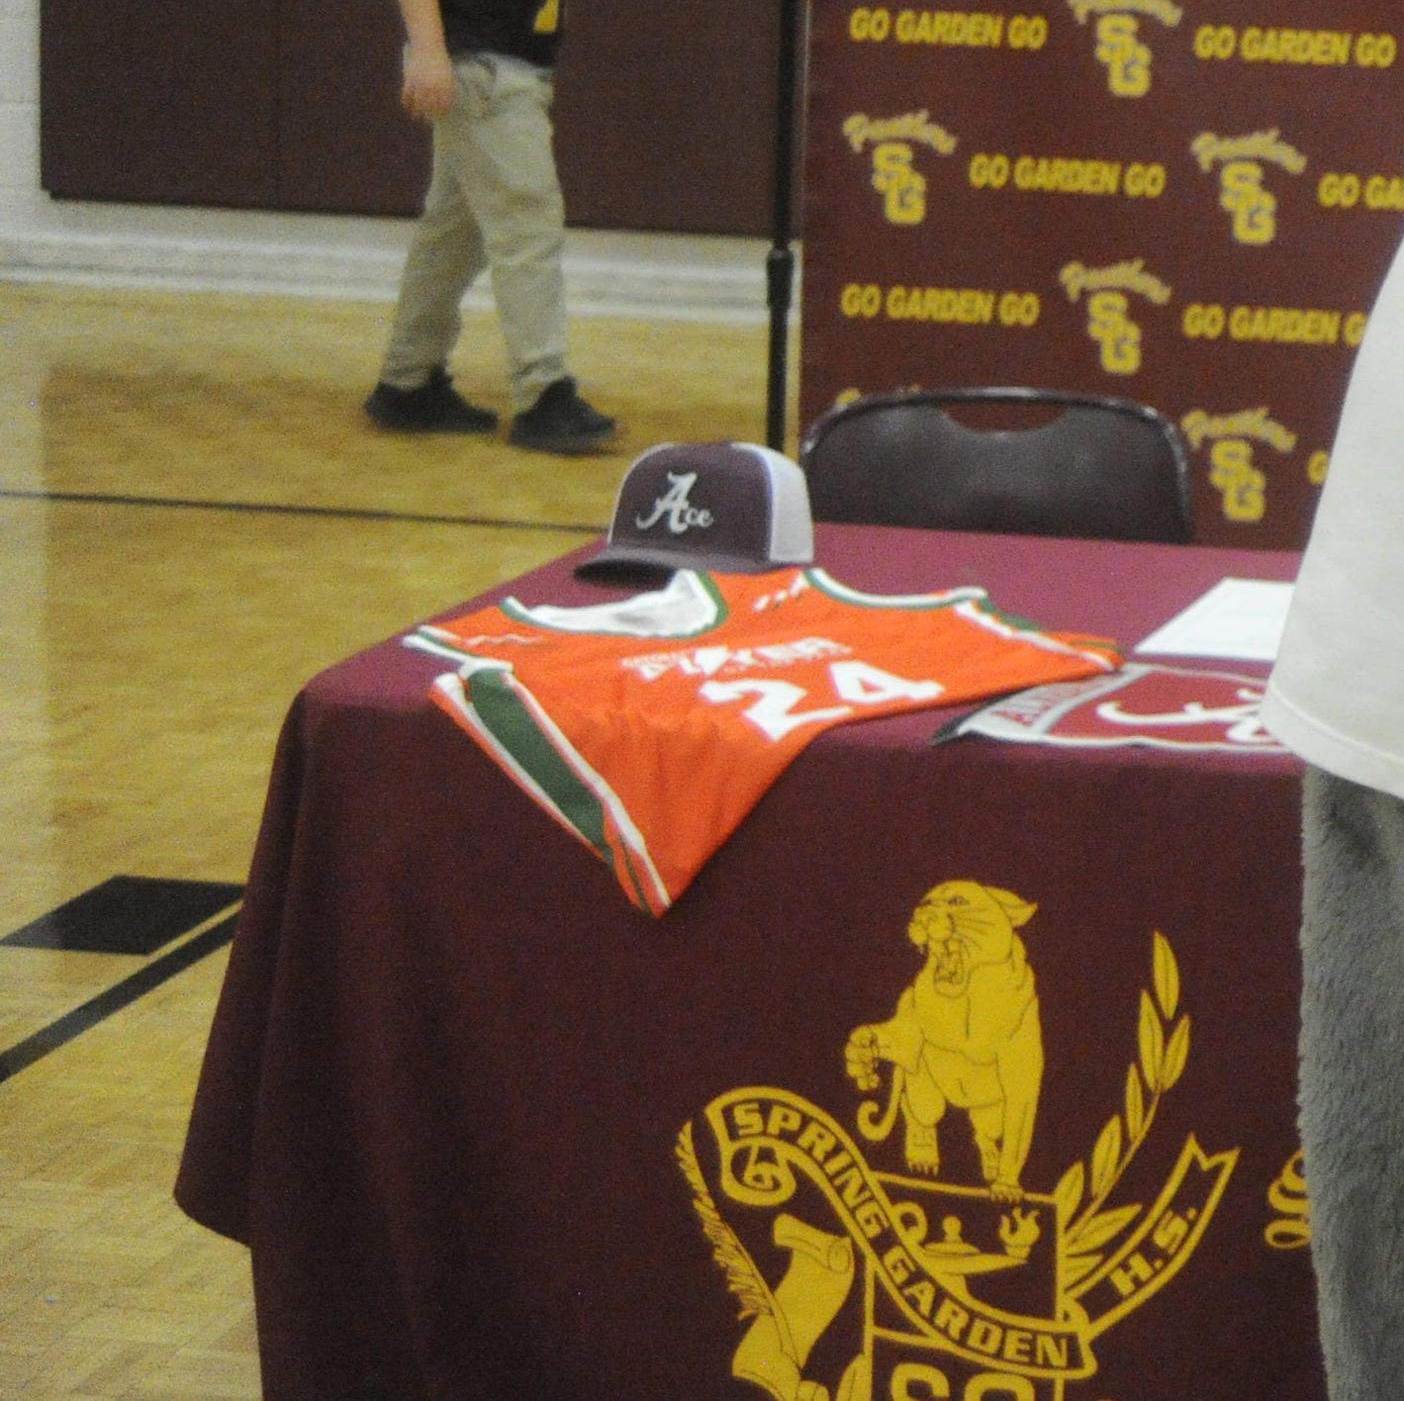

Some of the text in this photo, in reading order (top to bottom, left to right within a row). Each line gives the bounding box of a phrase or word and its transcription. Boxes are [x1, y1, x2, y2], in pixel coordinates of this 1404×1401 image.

[850, 6, 1049, 50] GO GARDEN GO
[1195, 24, 1399, 69] GO GARDEN GO
[968, 153, 1168, 199] GO GARDEN GO
[1318, 171, 1361, 209] GO
[841, 283, 1042, 327] GO GARDEN GO
[1183, 302, 1226, 340] GO
[1228, 305, 1342, 346] GARDEN
[699, 660, 946, 742] 24
[733, 1102, 890, 1235] SPRING
[1106, 1206, 1198, 1298] H.S.
[882, 1245, 1068, 1368] GARDEN
